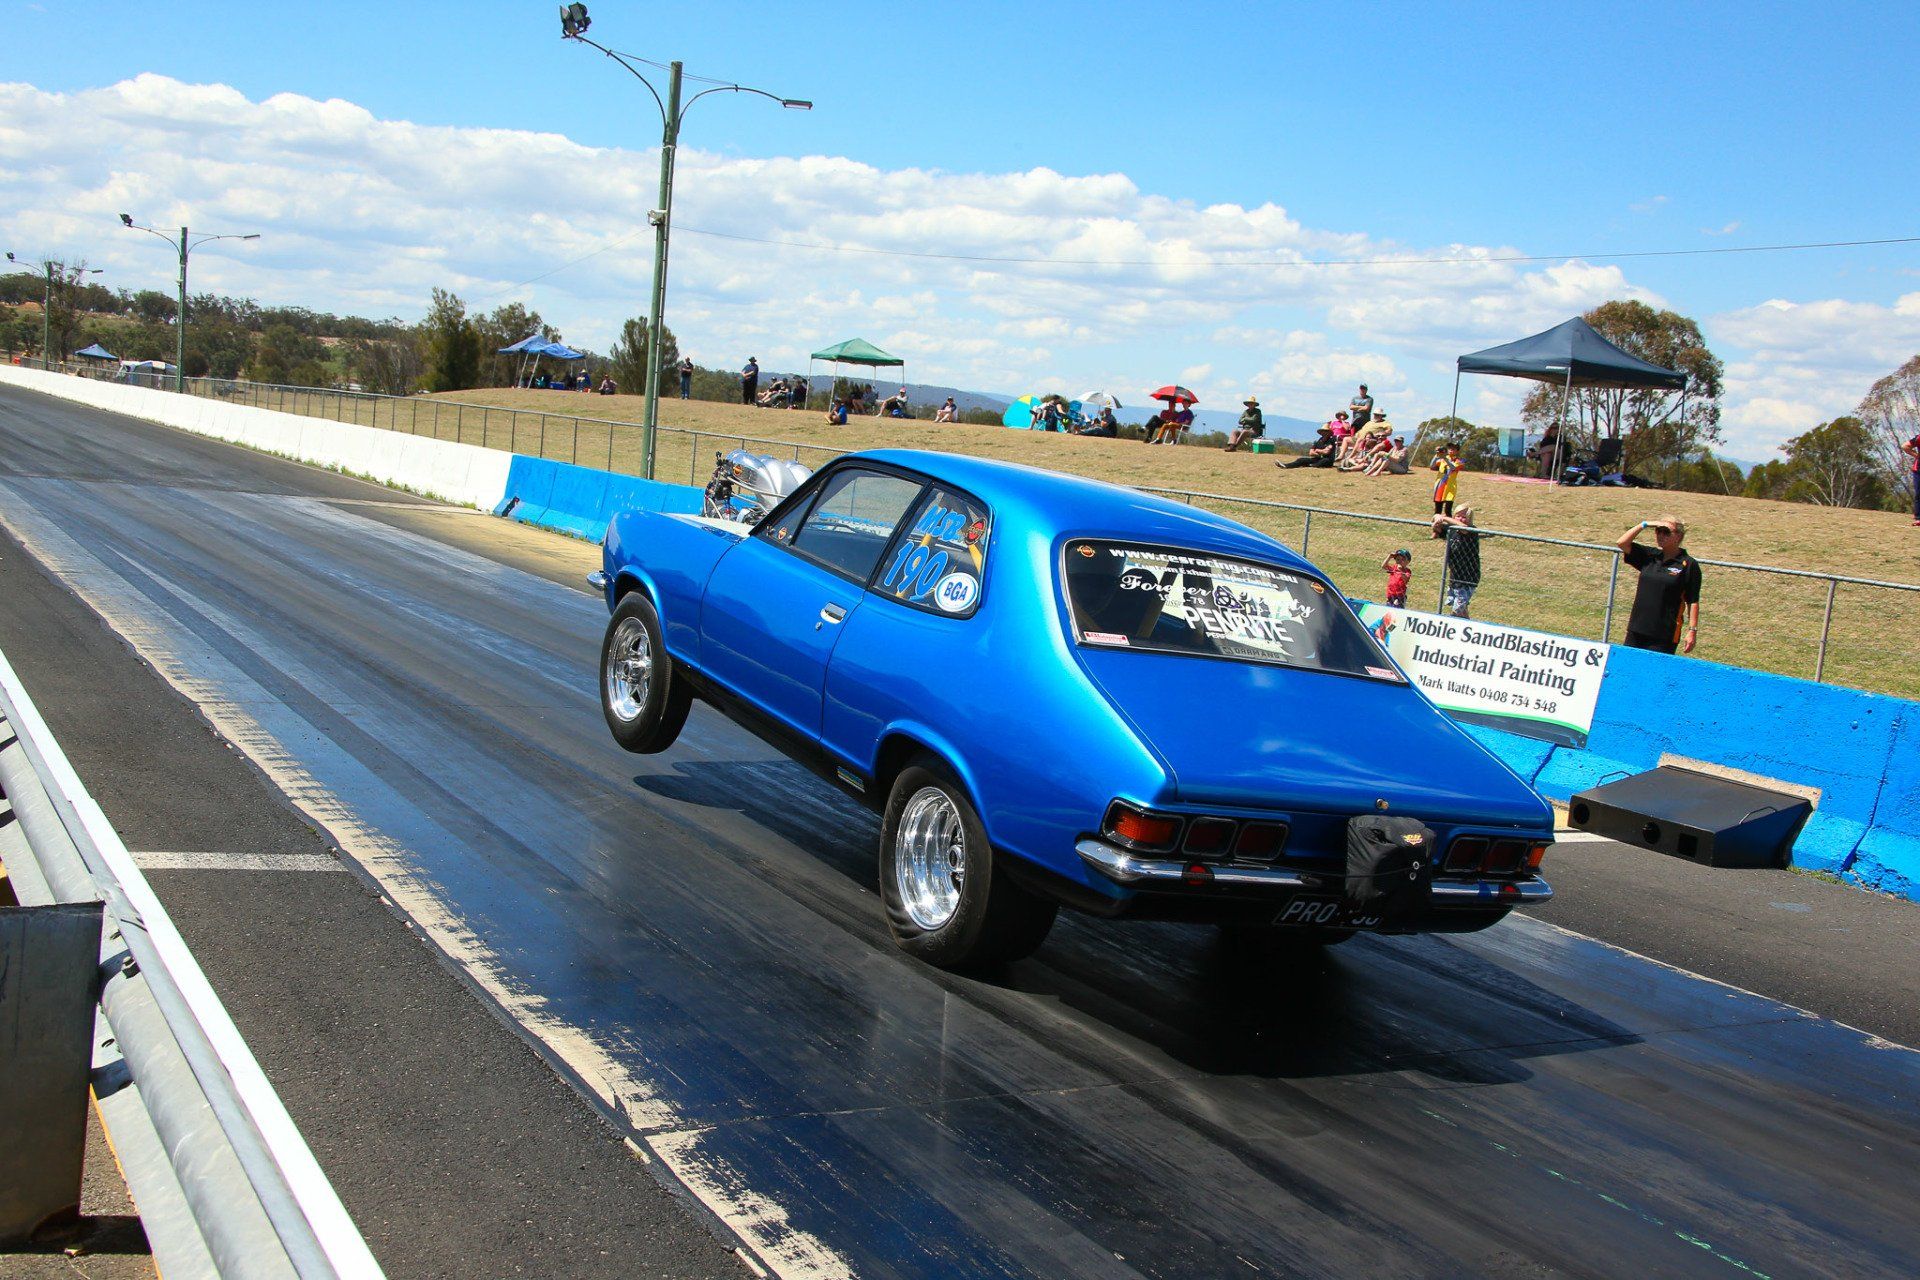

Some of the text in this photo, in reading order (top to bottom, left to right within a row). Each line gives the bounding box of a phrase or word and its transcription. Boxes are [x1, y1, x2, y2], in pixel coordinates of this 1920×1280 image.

[884, 542, 948, 596] 190
[1109, 549, 1298, 583] www.cesracing.com.au
[944, 581, 968, 601] BGA
[1182, 605, 1294, 643] PENRITE
[1404, 616, 1604, 667] Mobile SandBlasting &
[1412, 645, 1576, 697] Industrial Painting
[1417, 674, 1557, 714] Mark Watts 0408 734 548
